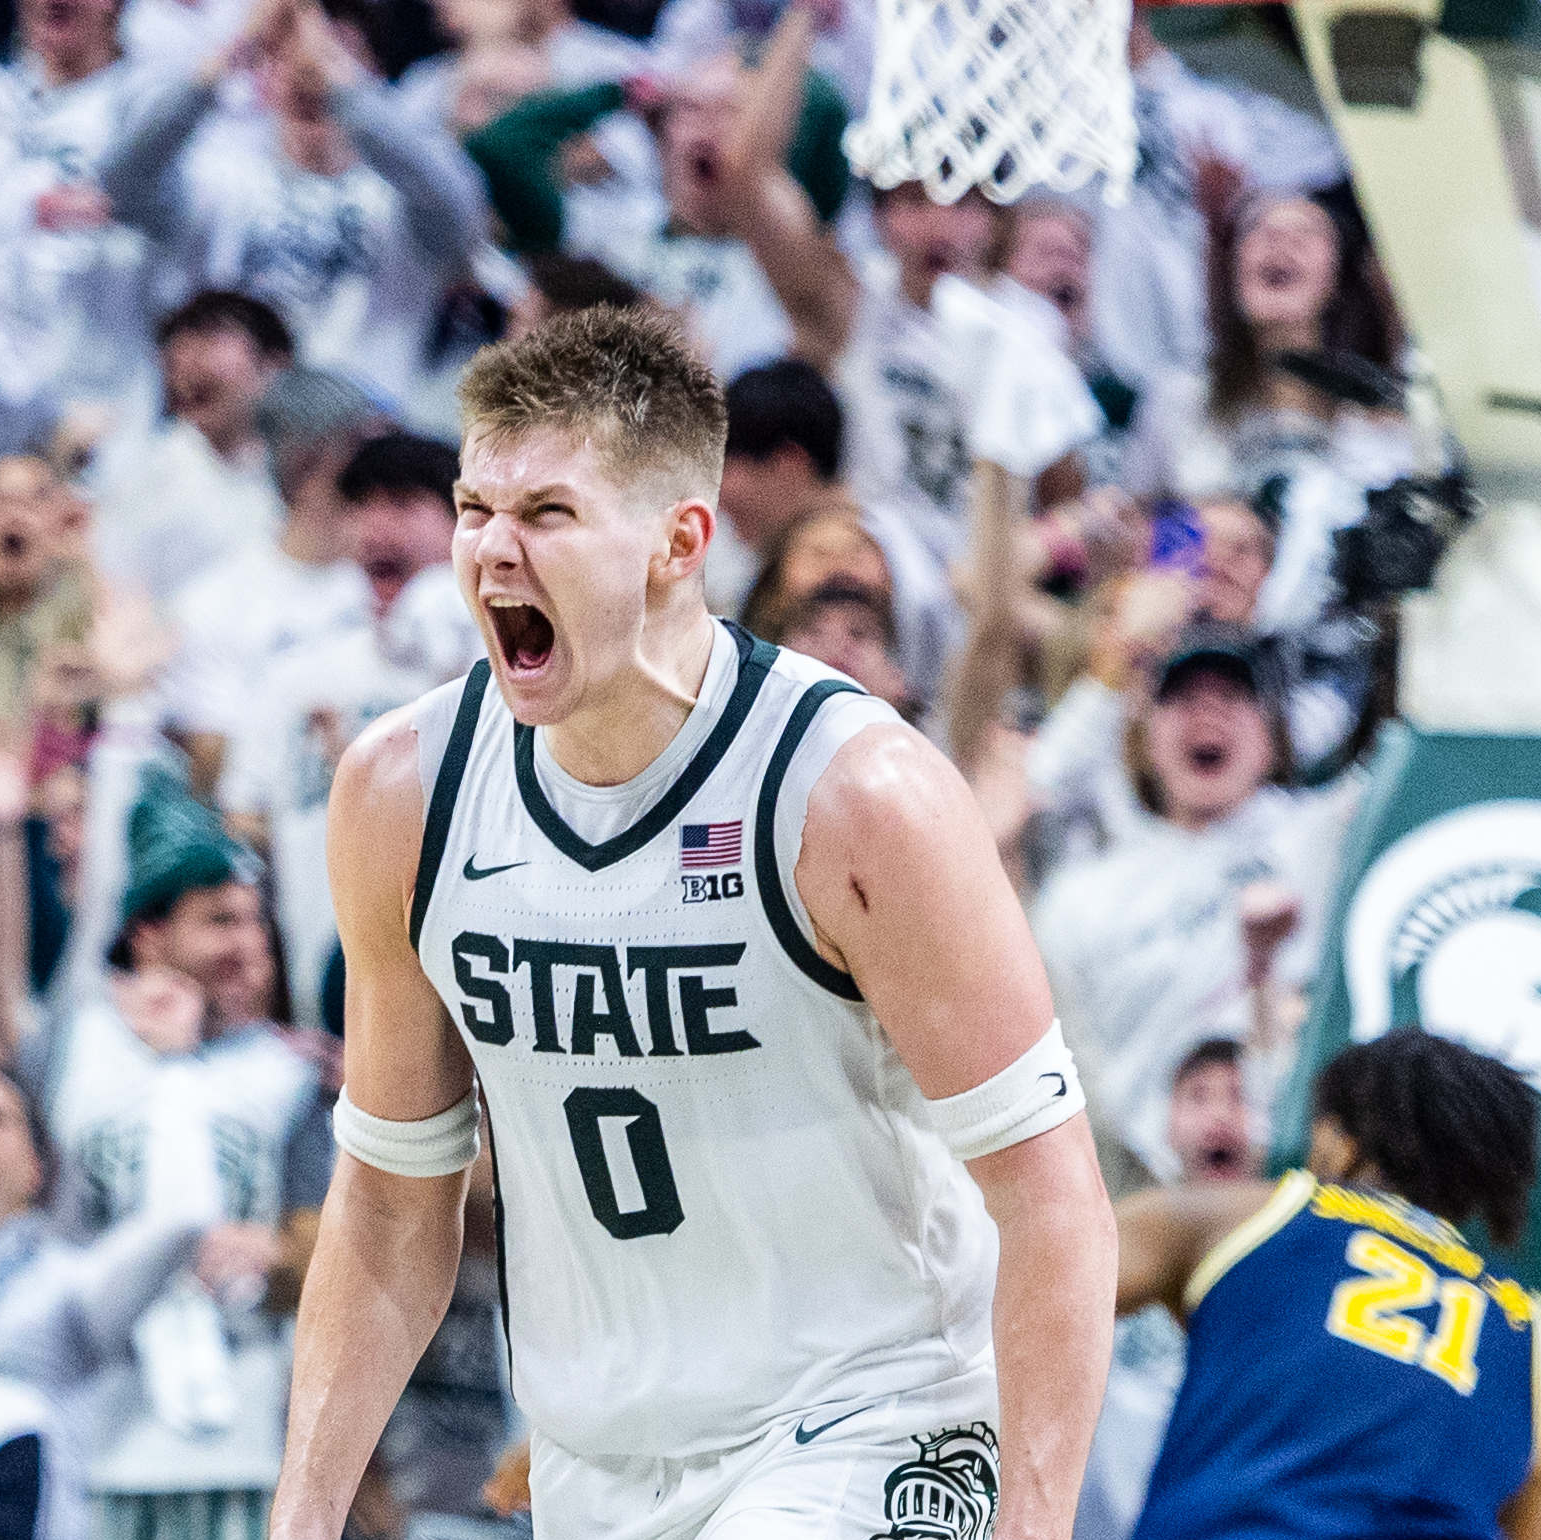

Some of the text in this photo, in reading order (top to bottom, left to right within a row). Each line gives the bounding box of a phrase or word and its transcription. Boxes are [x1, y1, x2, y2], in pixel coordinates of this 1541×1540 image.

[452, 929, 762, 1057] STATE
[562, 1085, 686, 1241] 0
[1323, 1227, 1488, 1398] 21
